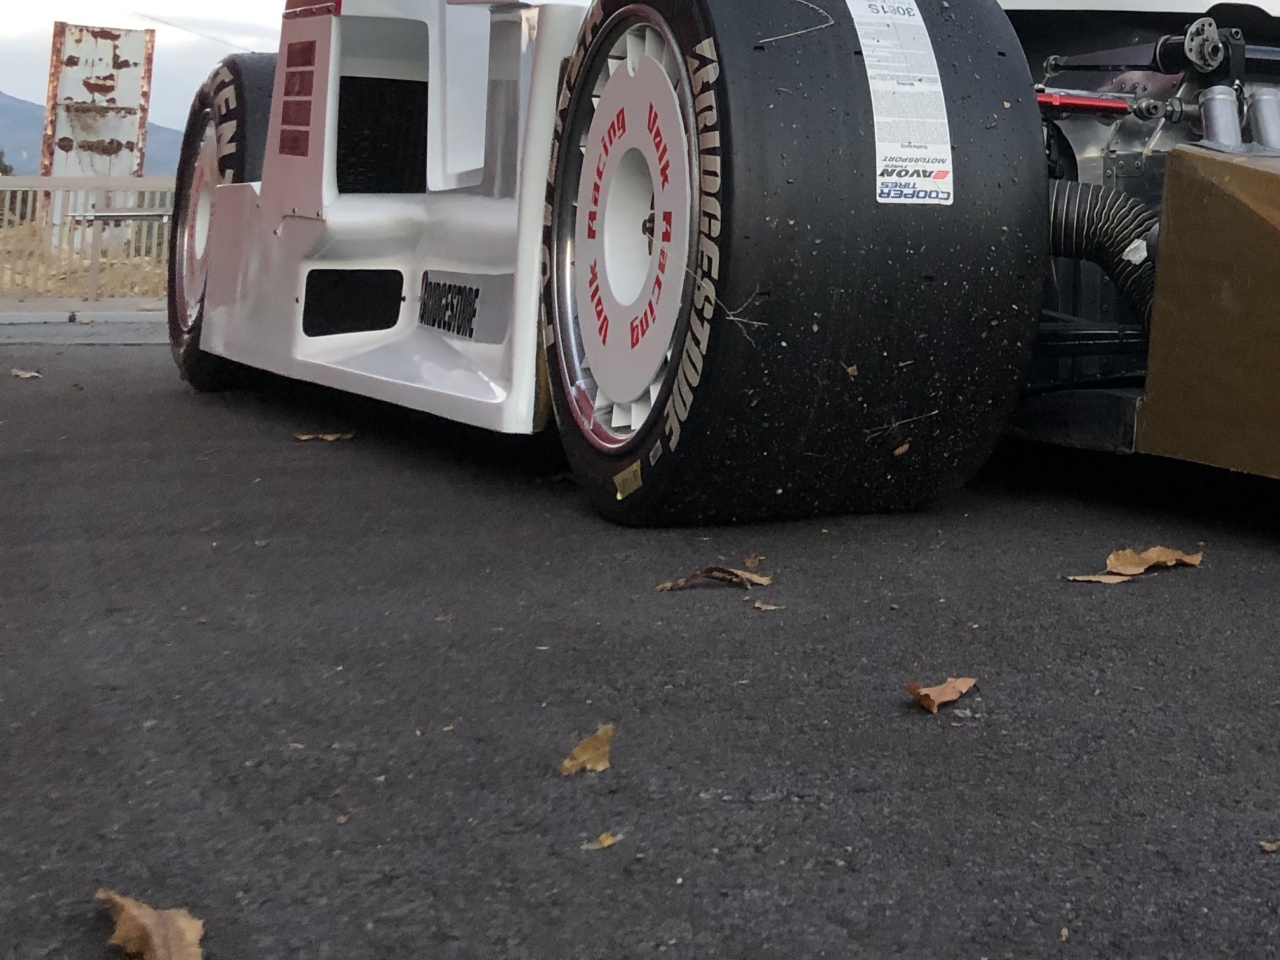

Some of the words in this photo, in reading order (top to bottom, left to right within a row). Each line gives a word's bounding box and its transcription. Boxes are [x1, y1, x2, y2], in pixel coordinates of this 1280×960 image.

[647, 101, 671, 192] Volk
[881, 155, 948, 164] MOTORSPORT
[878, 168, 935, 179] AVON
[879, 181, 917, 189] TIRES
[878, 188, 951, 201] COOPER
[664, 37, 721, 452] BRIDGESTONE
[588, 257, 610, 348] Volk
